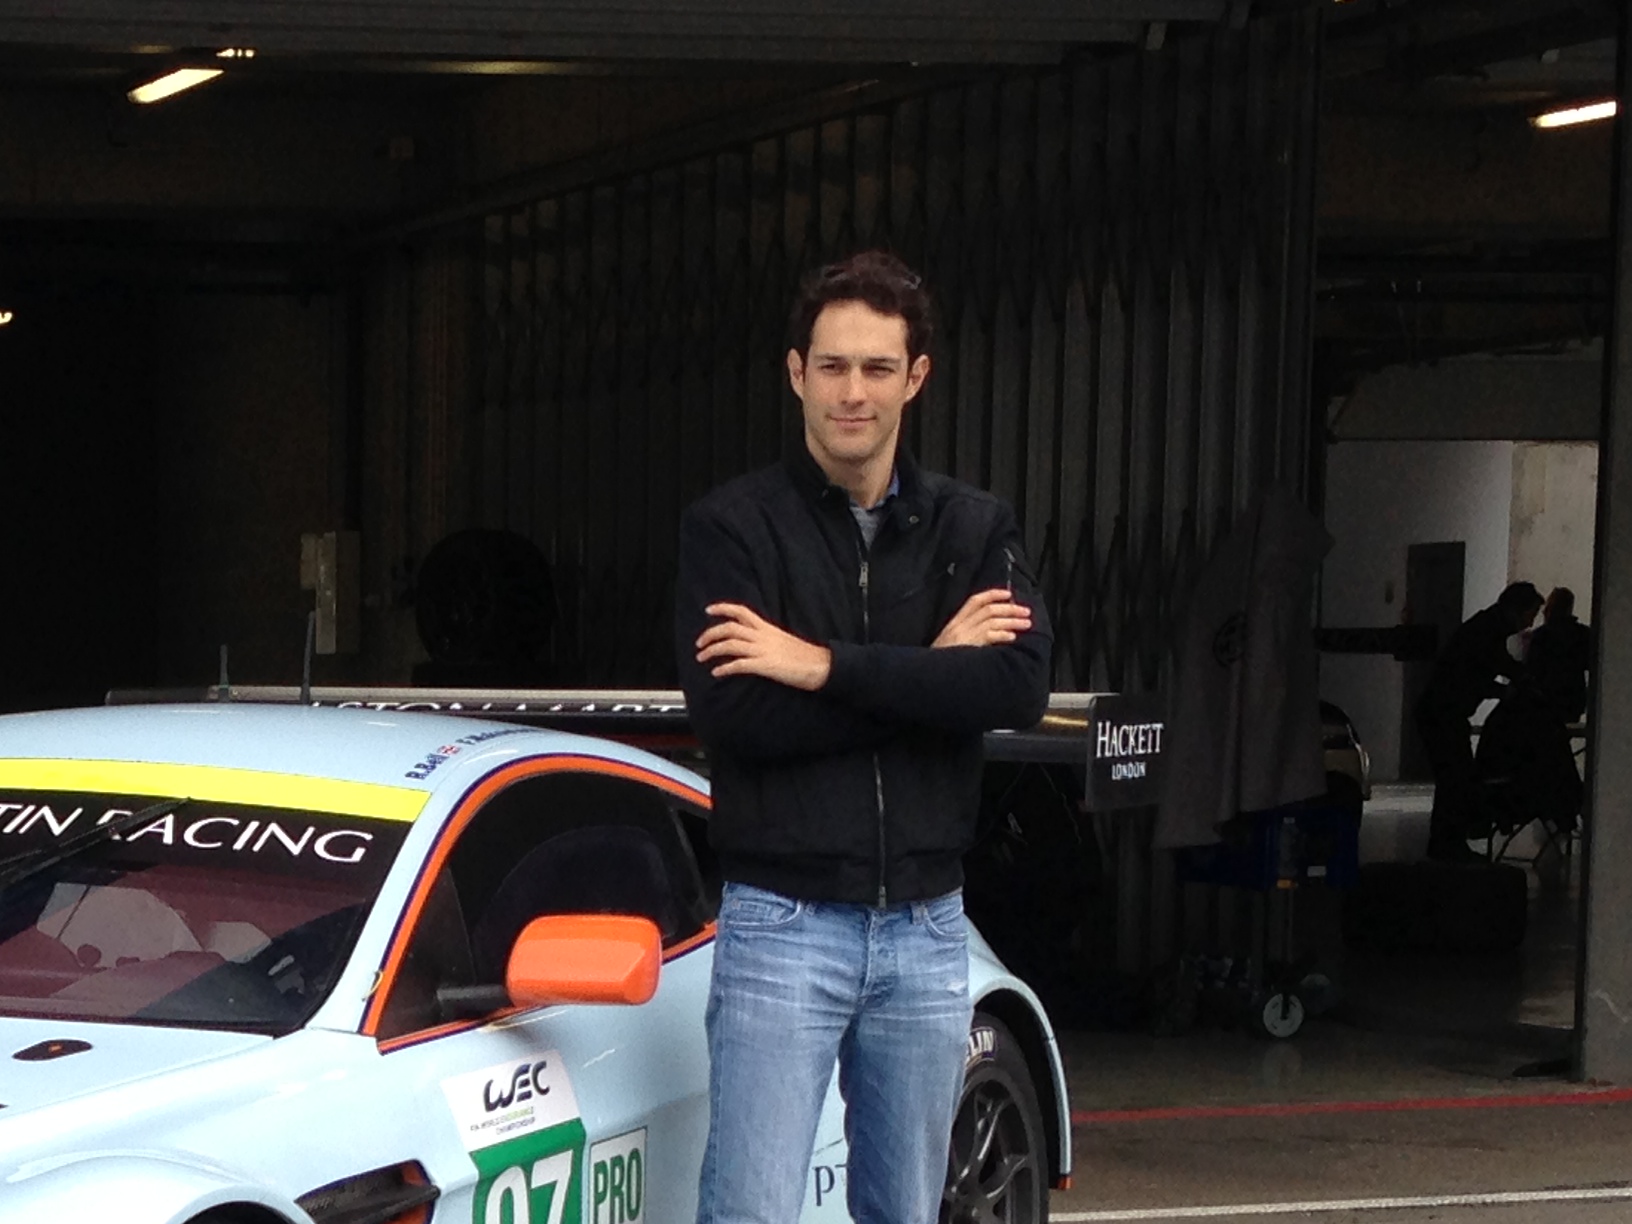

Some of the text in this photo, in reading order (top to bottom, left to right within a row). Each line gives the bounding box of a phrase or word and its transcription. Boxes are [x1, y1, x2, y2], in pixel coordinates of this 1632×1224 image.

[1096, 721, 1164, 758] HACKETT
[1112, 762, 1146, 780] LONDON
[484, 1061, 550, 1112] WEC
